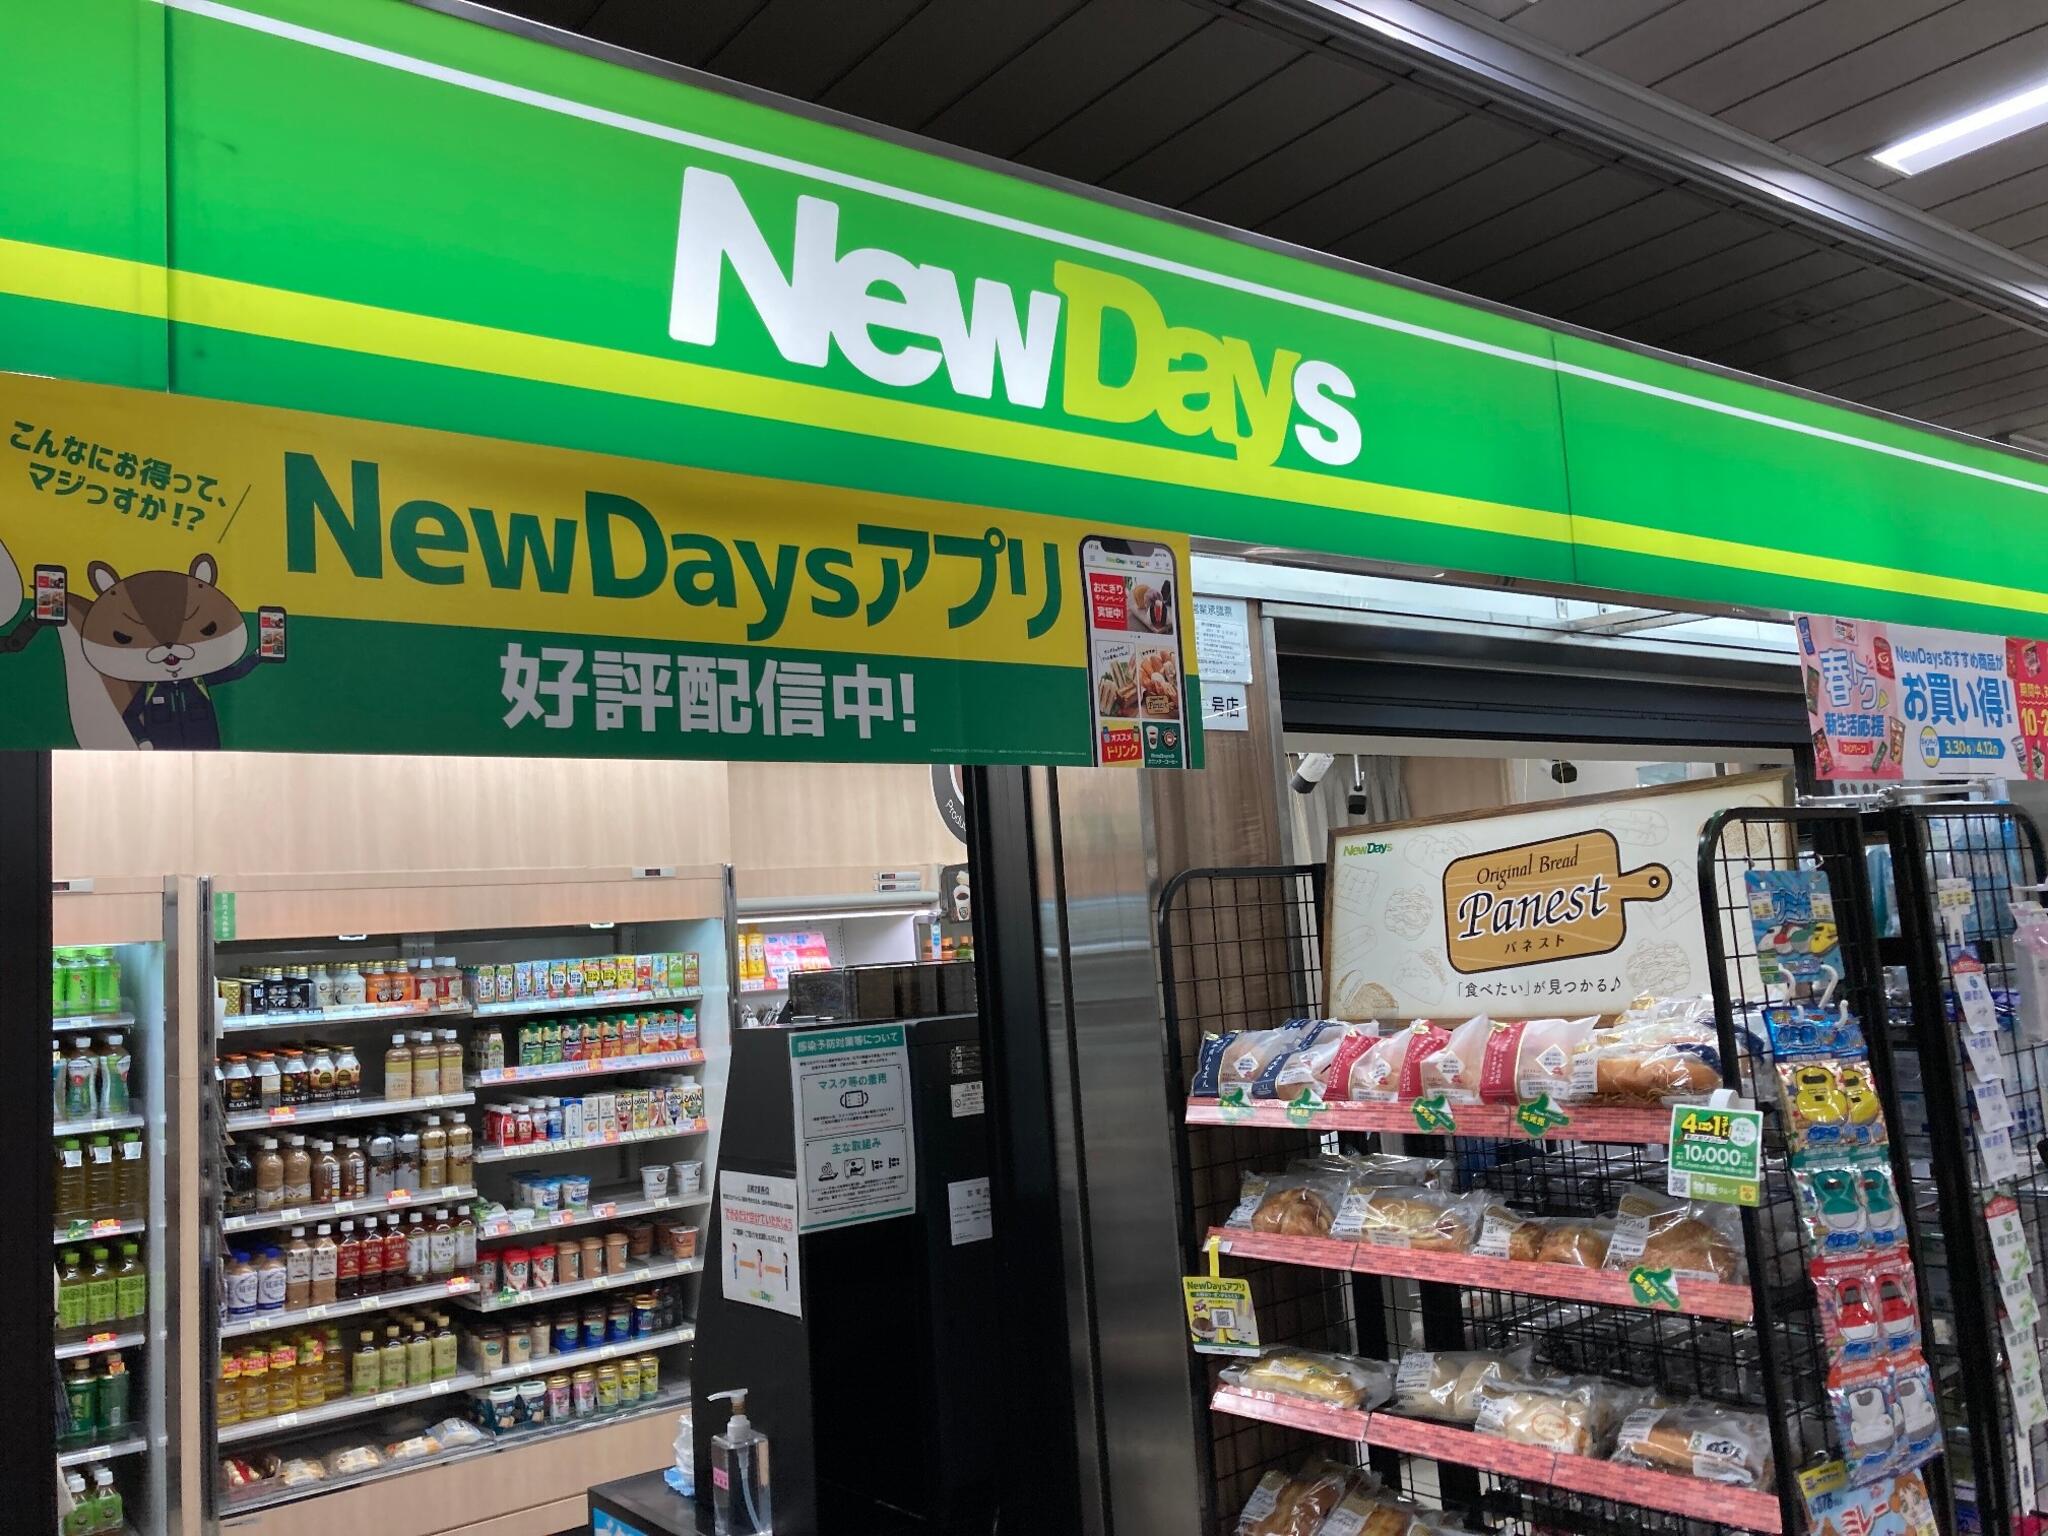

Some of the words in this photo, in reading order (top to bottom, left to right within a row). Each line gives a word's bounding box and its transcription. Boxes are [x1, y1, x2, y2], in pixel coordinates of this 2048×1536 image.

[669, 166, 1362, 467] NewDays
[10, 421, 229, 509] こんなにお得って、
[28, 462, 207, 532] マジっすか!?
[285, 451, 1062, 642] NewDaysアプリ
[1093, 582, 1123, 595] おにぎり
[1895, 645, 2004, 672] NewDaysおすすめ商品が
[499, 642, 917, 740] 好評配信中!
[1902, 671, 2012, 728] お買い得!
[1824, 711, 1885, 738] 新生活応援
[1106, 745, 1139, 760] ドリンク
[1343, 842, 1393, 857] NewDays
[1475, 853, 1532, 890] Original
[1539, 844, 1579, 873] Bread
[1457, 875, 1609, 941] Panest
[1504, 935, 1565, 954] パネスト
[1683, 1143, 1741, 1166] 10,000
[1186, 1281, 1246, 1292] NewDaysアプリ
